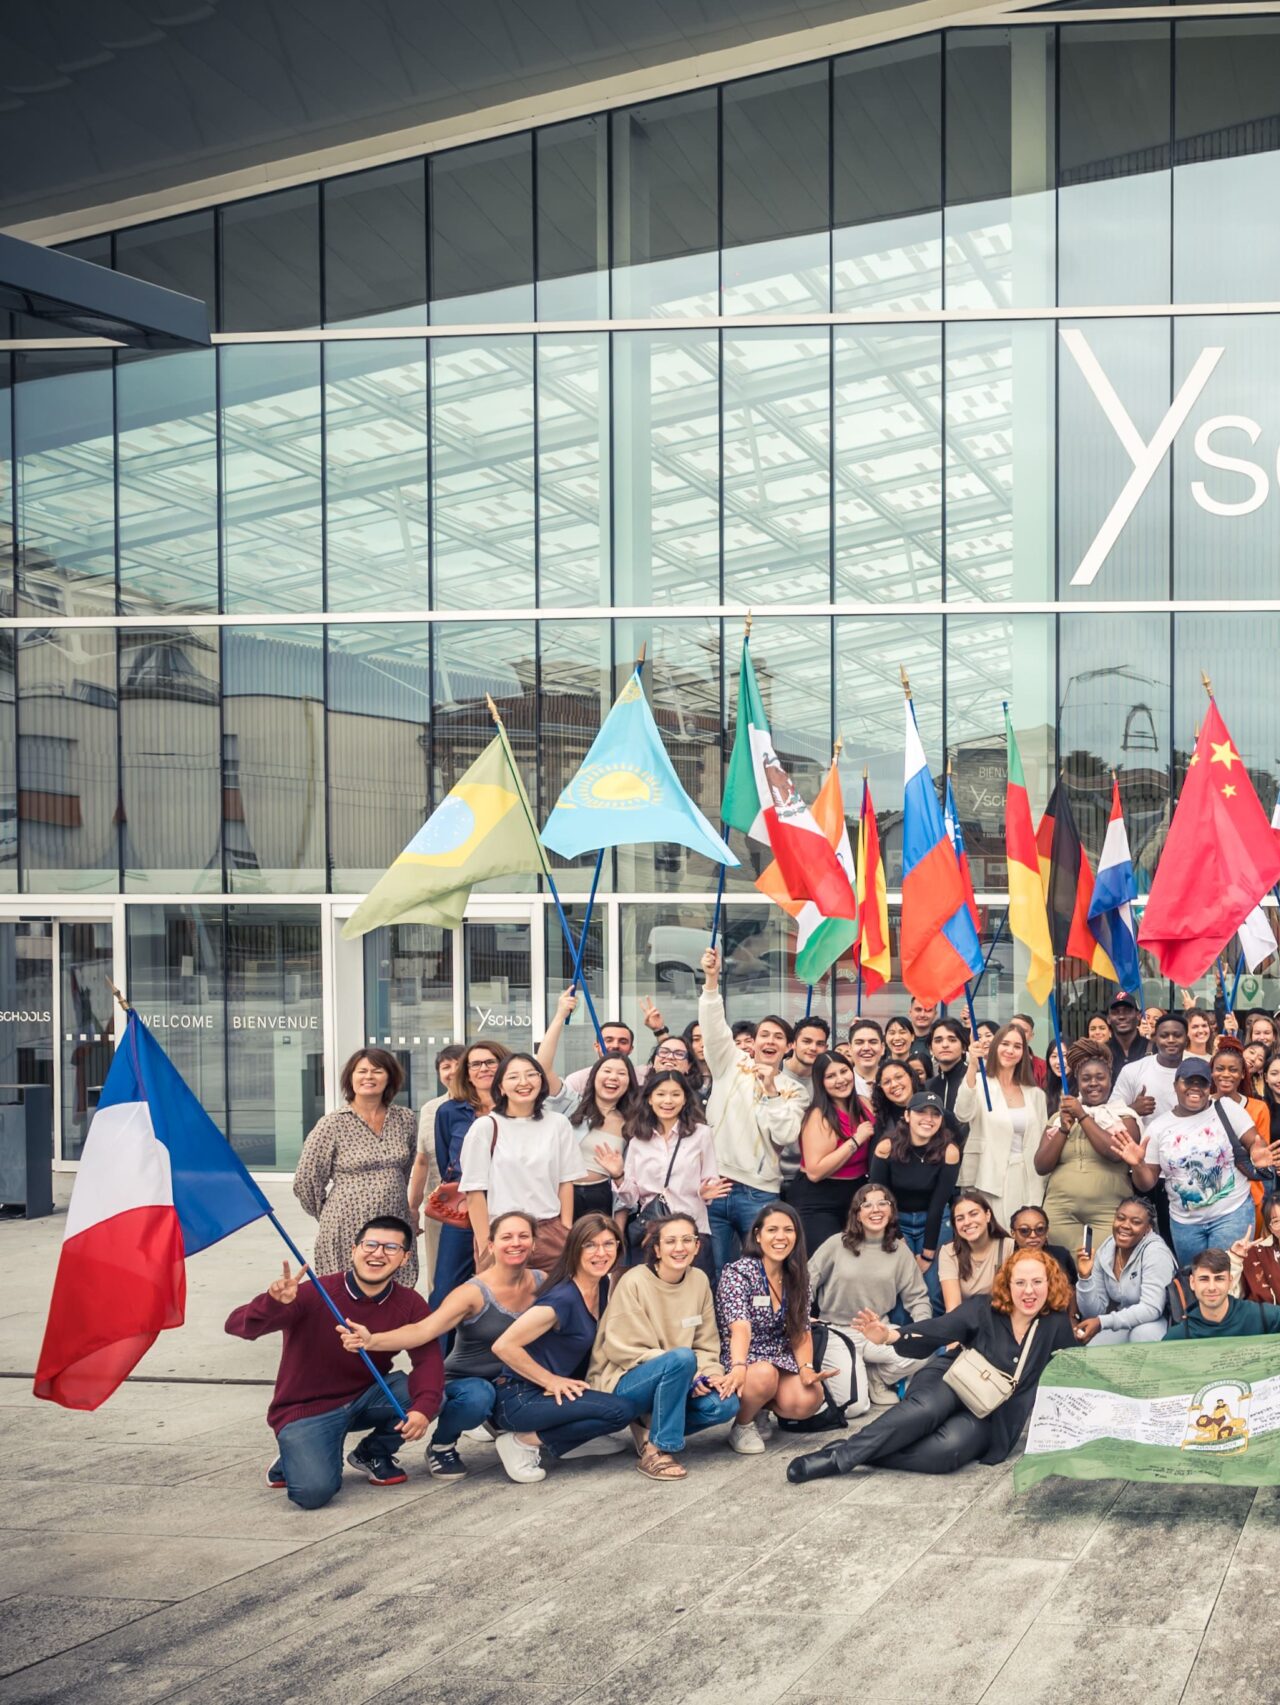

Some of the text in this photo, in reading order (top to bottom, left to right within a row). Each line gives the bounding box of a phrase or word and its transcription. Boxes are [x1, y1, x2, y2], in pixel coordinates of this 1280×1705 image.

[979, 767, 1008, 778] BIENV
[970, 785, 1007, 811] YSCH
[0, 1011, 51, 1022] SCHOOLS
[140, 1015, 318, 1029] WELCOME BIENVENUE
[476, 1006, 532, 1032] YSCHOO
